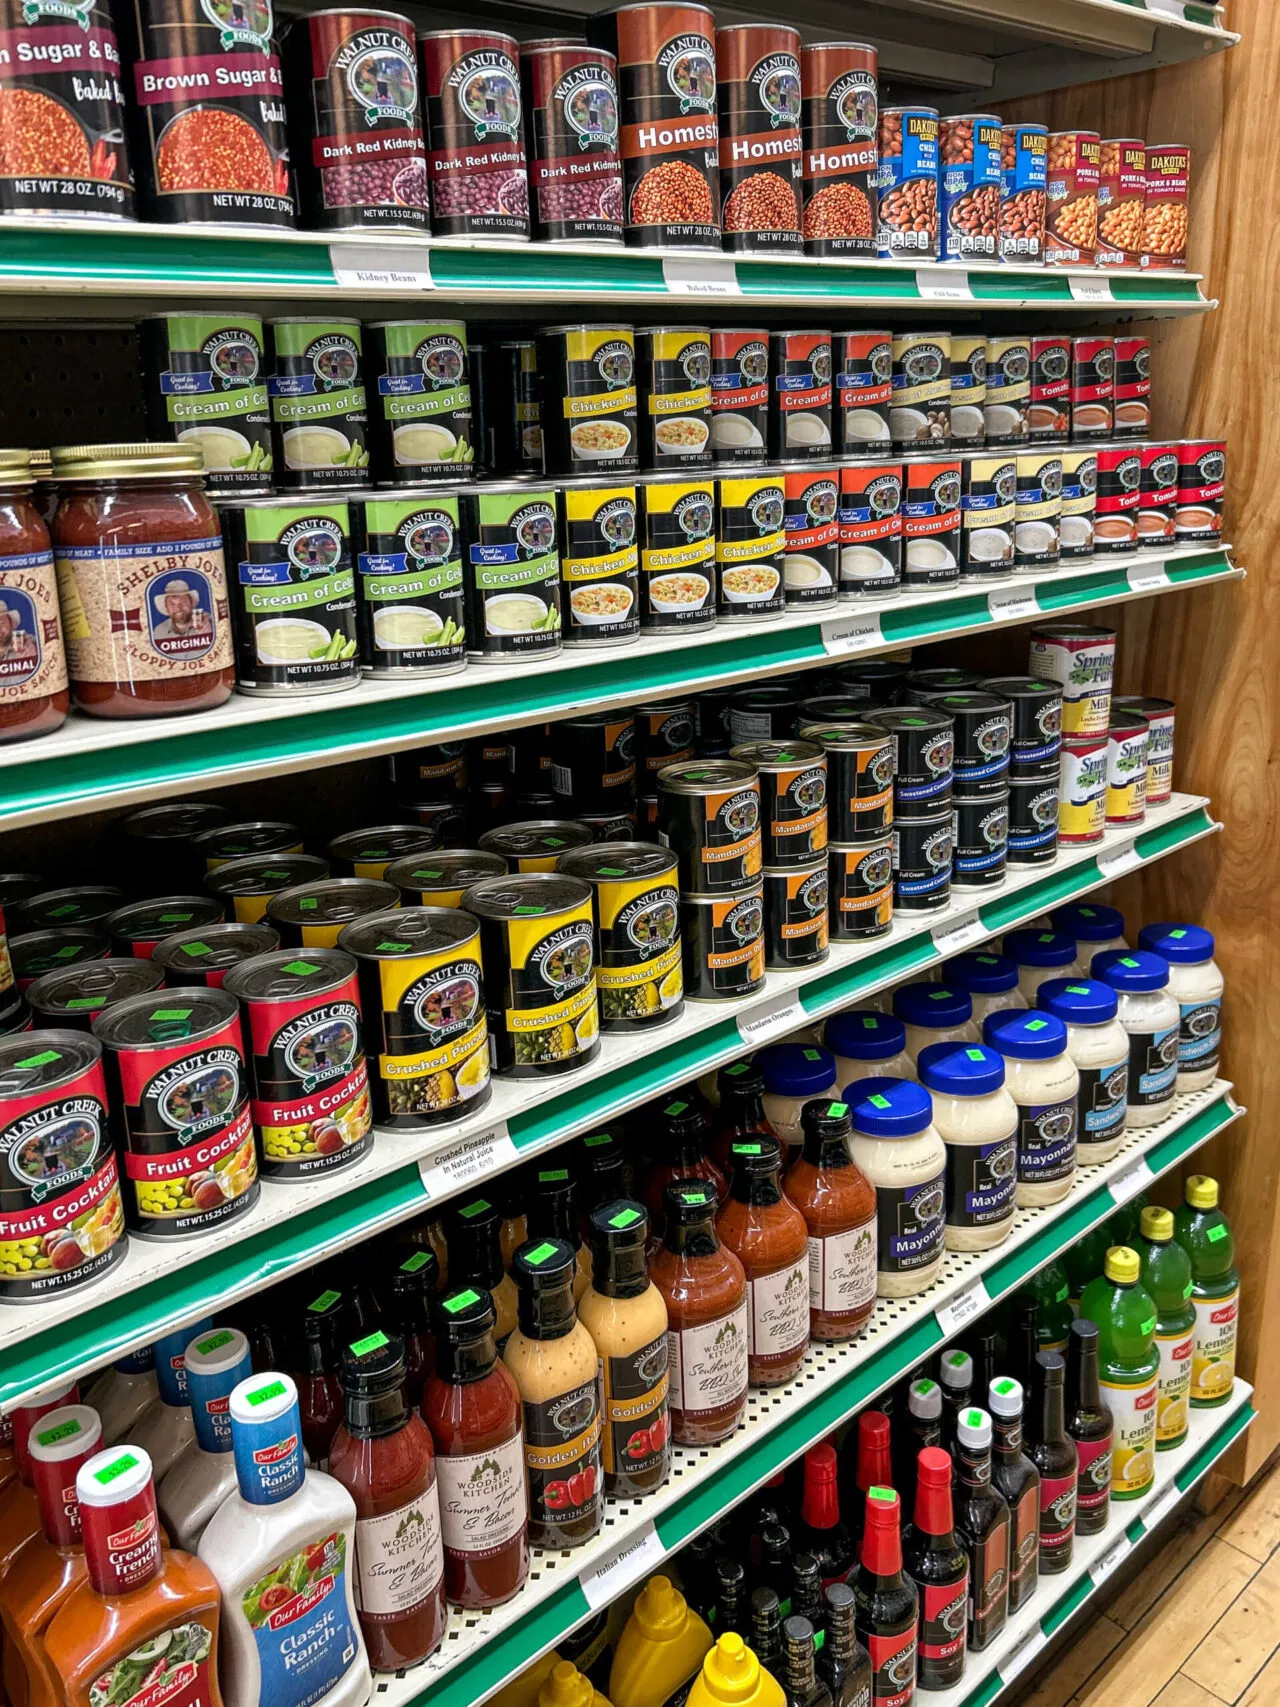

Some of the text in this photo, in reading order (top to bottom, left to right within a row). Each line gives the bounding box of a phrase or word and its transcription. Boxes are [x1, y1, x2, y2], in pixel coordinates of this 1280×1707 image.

[18, 41, 101, 62] Sugar &
[335, 32, 390, 71] WALNUT
[659, 37, 700, 69] WALNUT
[143, 67, 278, 92] Brown Sugar &
[448, 53, 498, 90] WALNUT
[752, 56, 790, 85] WALNUT
[554, 68, 600, 102] WALNUT
[377, 107, 407, 119] FOODS
[323, 138, 417, 159] Dark Red Kidney
[435, 152, 520, 171] Dark Red Kidney
[541, 160, 618, 178] Dark Red Kidney
[15, 180, 75, 194] NET WT 28
[213, 195, 263, 209] NET WT 28
[666, 226, 693, 235] NET WT
[356, 272, 417, 283] Kidney Beans
[203, 331, 240, 356] WALNUT
[173, 396, 249, 415] Cream of
[390, 394, 456, 414] Cream of
[570, 397, 622, 413] Chicken
[656, 396, 704, 410] Chicken
[712, 391, 761, 406] Cream of
[785, 391, 829, 406] Cream of
[845, 391, 888, 403] Cream of
[279, 399, 349, 417] Cream of
[398, 512, 433, 537] WALNUT
[510, 504, 540, 528] WALNUT
[906, 518, 953, 532] Cream of
[281, 519, 316, 546] WALNUT
[818, 531, 828, 542] of
[840, 524, 892, 539] Cream of
[104, 545, 173, 556] FAMILY SIZE ADD
[650, 550, 701, 566] Chicken
[723, 542, 773, 559] Chicken
[117, 555, 224, 596] SHELBY JOES
[370, 563, 395, 572] Cooking!
[482, 563, 549, 584] Cream of
[570, 561, 625, 576] Chicken
[251, 573, 278, 582] Cooking!
[370, 573, 444, 595] Cream of
[251, 583, 330, 607] Cream of
[525, 636, 535, 644] WT
[856, 627, 875, 637] Chicken
[161, 636, 211, 651] ORIGINAL
[181, 658, 206, 670] JOE
[403, 651, 414, 659] NET
[287, 666, 299, 674] NET
[1015, 750, 1043, 760] Sweetened
[900, 786, 930, 797] Sweetened
[719, 792, 745, 816] WALNUT
[854, 795, 886, 810] Mandarin
[775, 819, 815, 834] Mandarin
[706, 845, 744, 861] Mandarin
[959, 859, 989, 869] Sweetened
[901, 883, 931, 894] Sweetened
[844, 898, 879, 911] Mandarin
[785, 920, 819, 936] Mandarin
[531, 925, 574, 962] WALNUT
[712, 952, 750, 967] Mandarin
[602, 966, 654, 986] Crushed
[404, 968, 453, 1008] WALNUT
[513, 1008, 570, 1027] Crushed
[745, 1008, 794, 1033] Mandarin Oranges
[273, 1007, 327, 1052] WALNUT
[441, 1020, 469, 1034] FOODS
[316, 1065, 345, 1081] FOODS
[386, 1056, 449, 1075] Crushed
[146, 1056, 206, 1100] WALNUT
[273, 1104, 315, 1121] Fruit
[0, 1099, 103, 1154] WALNUT CREEK
[191, 1115, 225, 1132] FOODS
[146, 1115, 251, 1176] Fruit Cocktail
[434, 1131, 496, 1165] Crushed Pineapple
[443, 1146, 494, 1174] In Natural Juice
[46, 1169, 83, 1189] FOODS
[979, 1183, 992, 1191] Real
[0, 1163, 115, 1235] Fruit Cocktail
[904, 1225, 917, 1235] Real
[31, 1268, 84, 1289] NET 15.25
[208, 1335, 230, 1350] $2.99
[688, 1356, 734, 1377] Southern
[699, 1377, 726, 1392] BBQ
[612, 1396, 660, 1420] Golden
[50, 1424, 77, 1442] $3.29
[527, 1447, 578, 1464] Golden
[258, 1454, 299, 1477] Classic
[261, 1466, 299, 1488] Ranch
[457, 1466, 514, 1489] WOODSIDE
[463, 1478, 511, 1495] KITCHEN
[444, 1500, 493, 1515] Summer
[381, 1515, 434, 1548] WOODSIDE
[110, 1531, 159, 1566] Creamy
[388, 1527, 433, 1557] KITCHEN
[115, 1546, 157, 1576] French
[449, 1549, 469, 1557] TASTE
[596, 1537, 647, 1578] Italian Dressing
[367, 1558, 416, 1578] Summer
[274, 1610, 295, 1627] Our
[280, 1611, 335, 1654] Classic
[284, 1625, 335, 1670] Ranch
[940, 1644, 958, 1655] Soy
[296, 1647, 329, 1674] DRESSING
[887, 1698, 903, 1707] Soy
